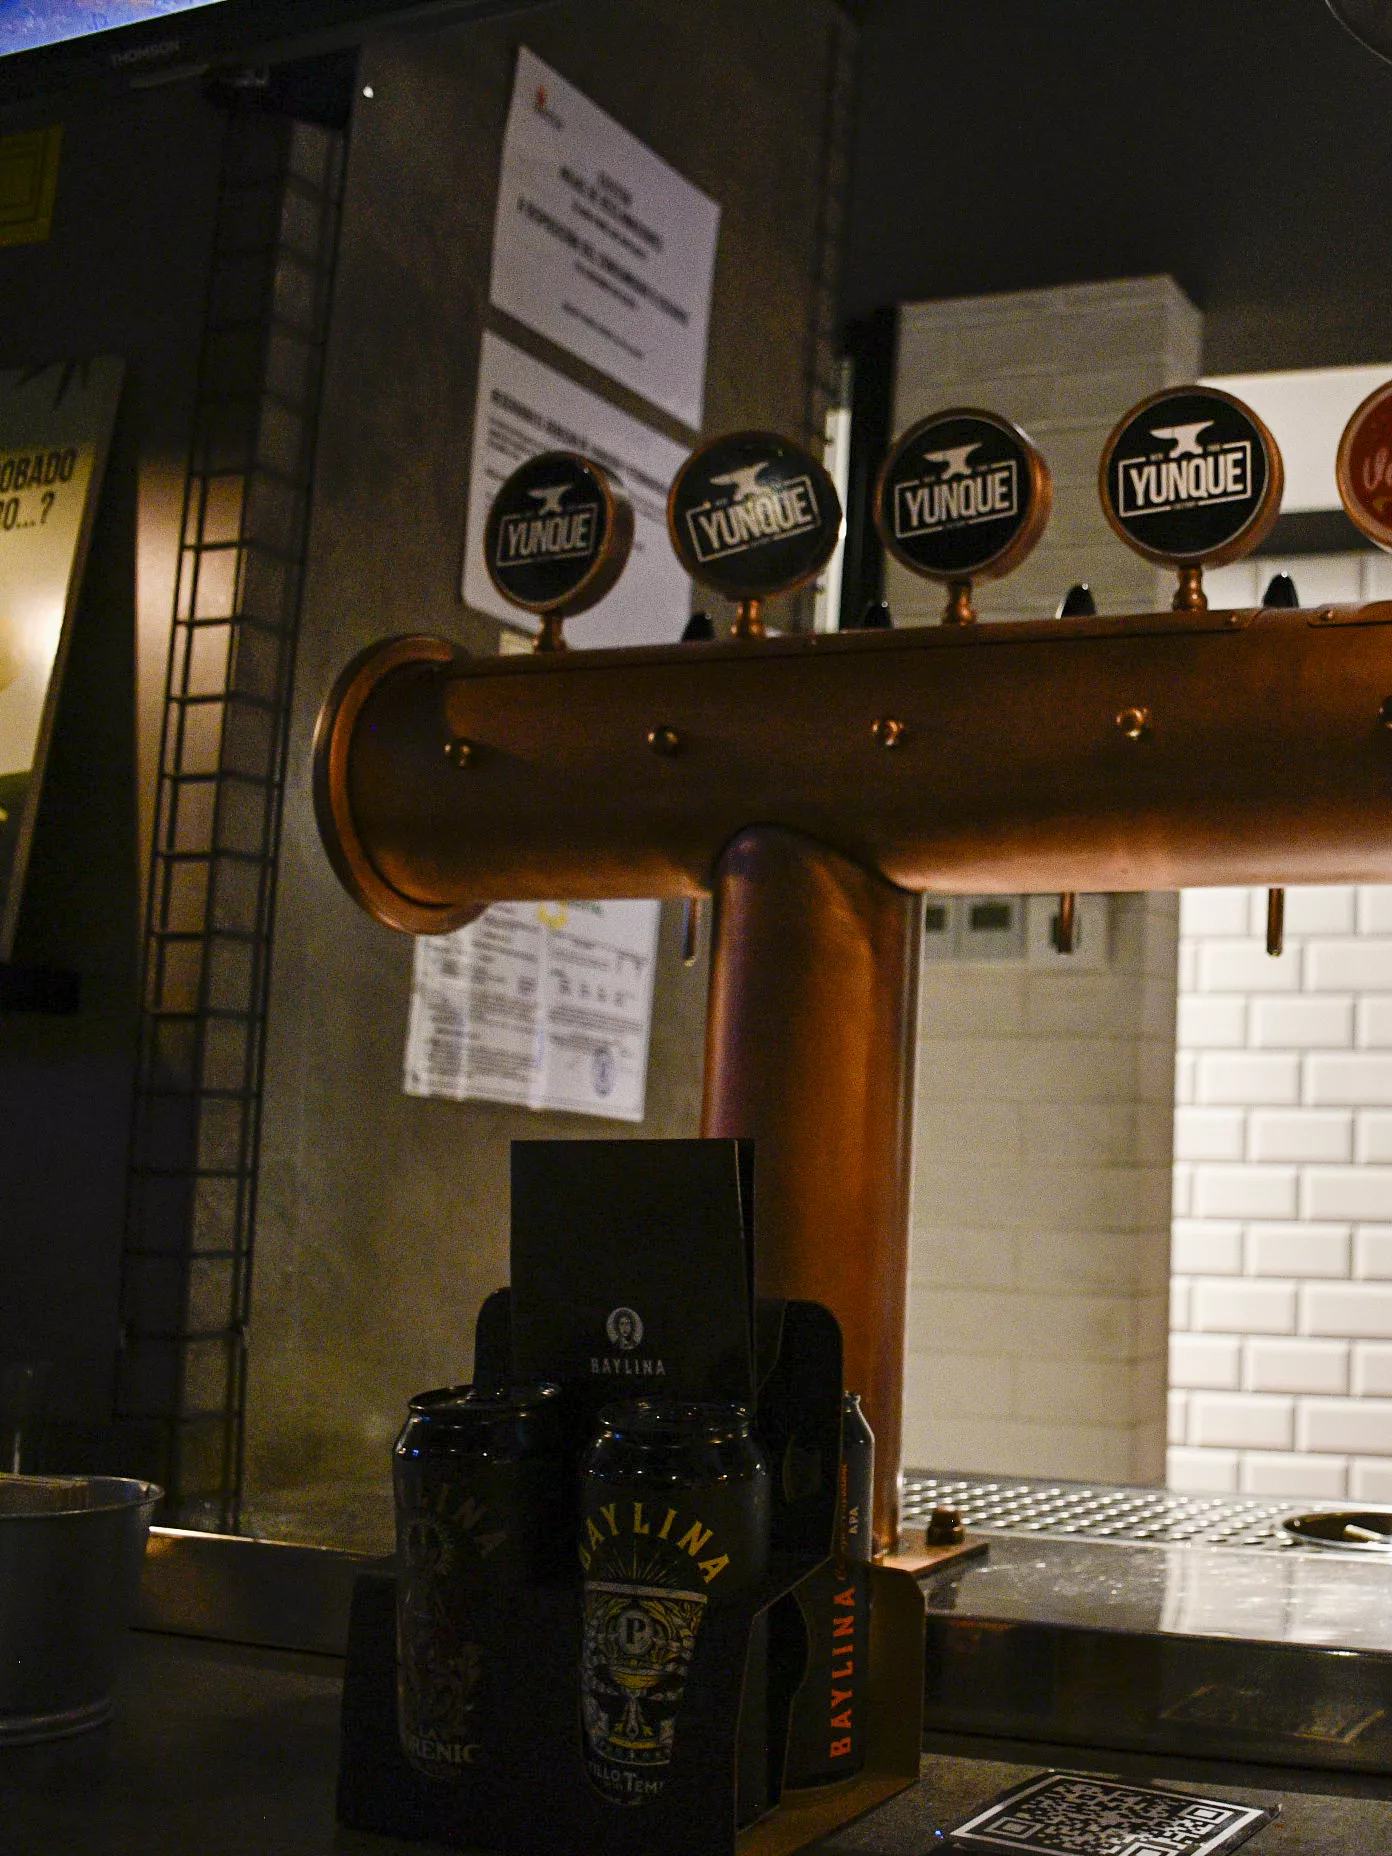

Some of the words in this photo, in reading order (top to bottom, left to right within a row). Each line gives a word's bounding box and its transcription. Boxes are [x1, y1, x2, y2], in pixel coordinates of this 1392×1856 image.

[903, 469, 1012, 528] YUNQUE
[1128, 450, 1245, 507] YUNQUE
[507, 512, 593, 557] YUNQUE
[697, 485, 814, 550] YUNQUE
[589, 1358, 667, 1377] BAYLINA
[829, 1585, 857, 1759] BAYLINA
